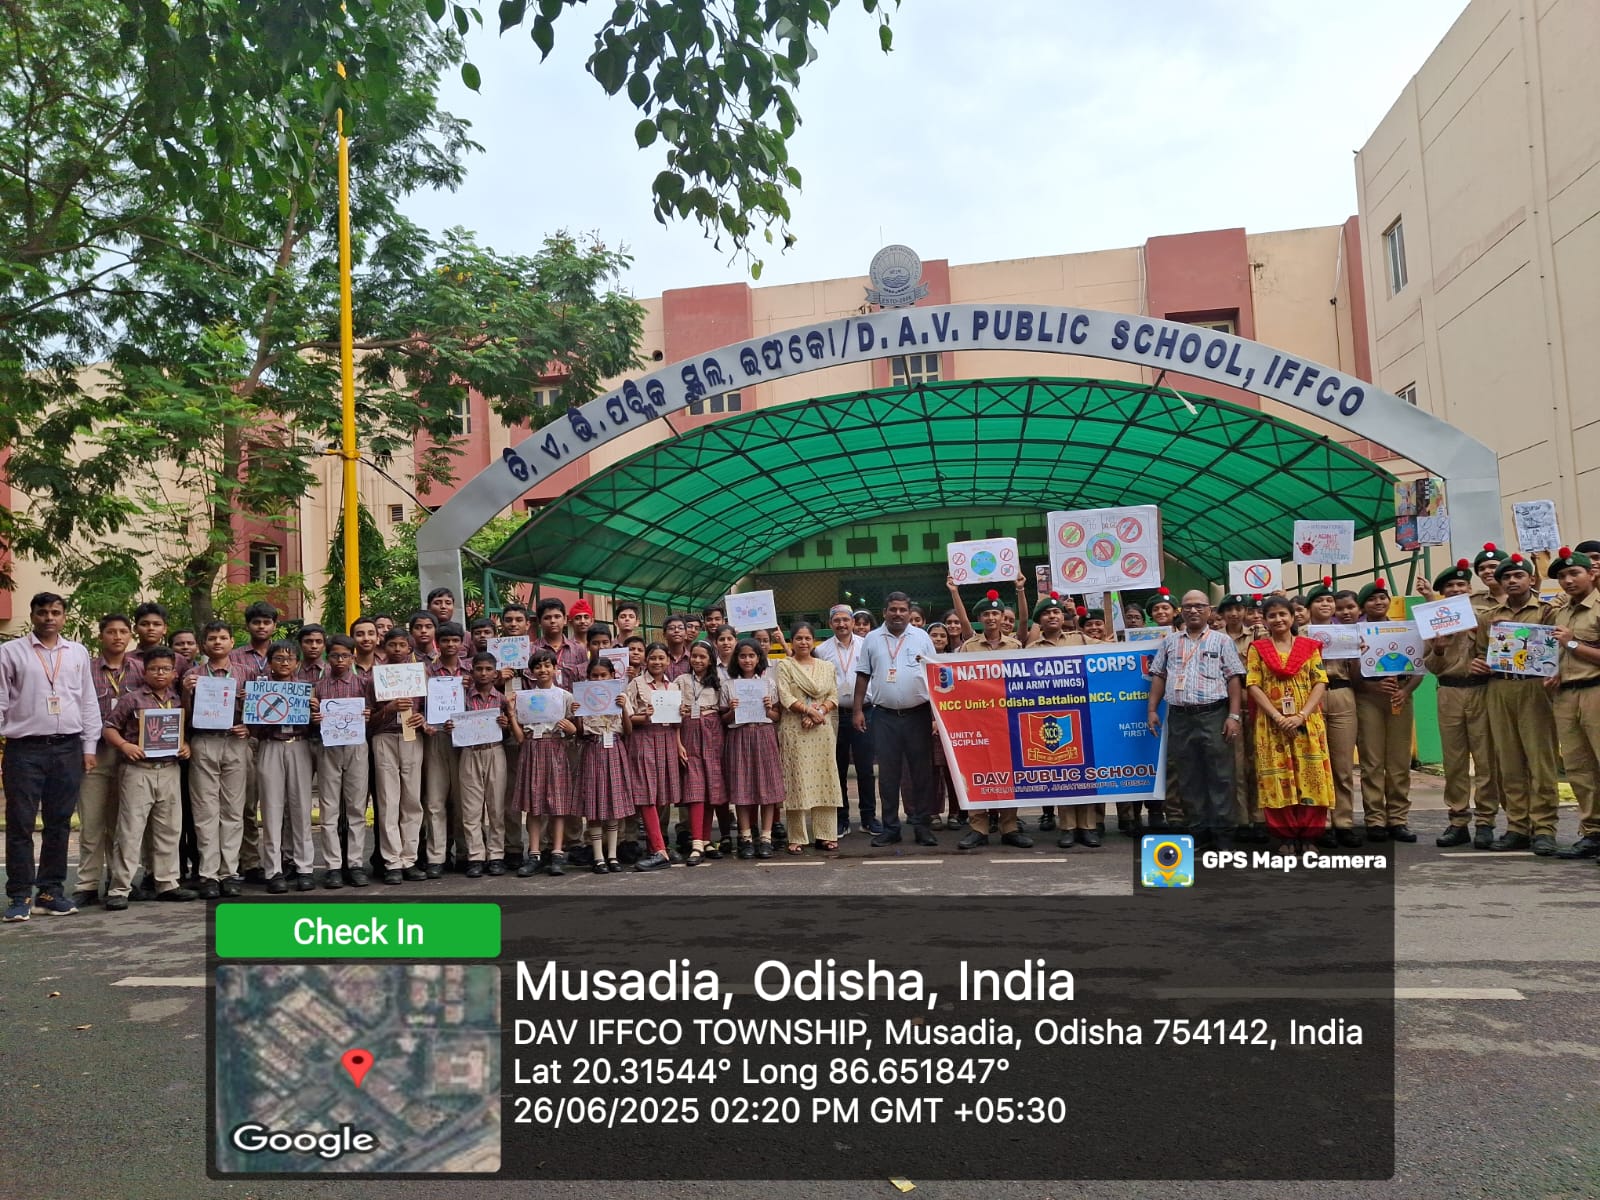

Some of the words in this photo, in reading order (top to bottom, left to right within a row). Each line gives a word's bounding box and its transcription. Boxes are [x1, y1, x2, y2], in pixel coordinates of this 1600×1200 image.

[972, 310, 1090, 345] PUBLIC
[1111, 319, 1255, 389] SCHOOL,
[1263, 355, 1366, 417] IFFCO
[957, 661, 1031, 681] NATIONAL
[1034, 658, 1082, 677] CADET
[1086, 655, 1137, 673] CORPS
[253, 682, 278, 693] DRUG
[282, 683, 312, 696] ABUSE
[1008, 681, 1024, 692] (AN
[1026, 679, 1051, 691] ARMY
[1053, 678, 1085, 689] WINGS)
[288, 697, 301, 707] SAY
[939, 700, 962, 711] NCC
[965, 699, 995, 710] Unit-1
[998, 696, 1035, 708] Odisha
[1038, 694, 1086, 706] Battalion
[1089, 692, 1116, 704] NCC,
[1118, 690, 1150, 701] Cutta
[246, 713, 259, 722] TH
[287, 715, 309, 723] DRUGS
[950, 731, 974, 739] UNITY
[1044, 727, 1059, 738] NCC
[951, 738, 990, 747] SCIPLINE
[972, 772, 1010, 786] DAV
[1014, 768, 1081, 784] PUBLIC
[1085, 764, 1157, 780] SCHOOL
